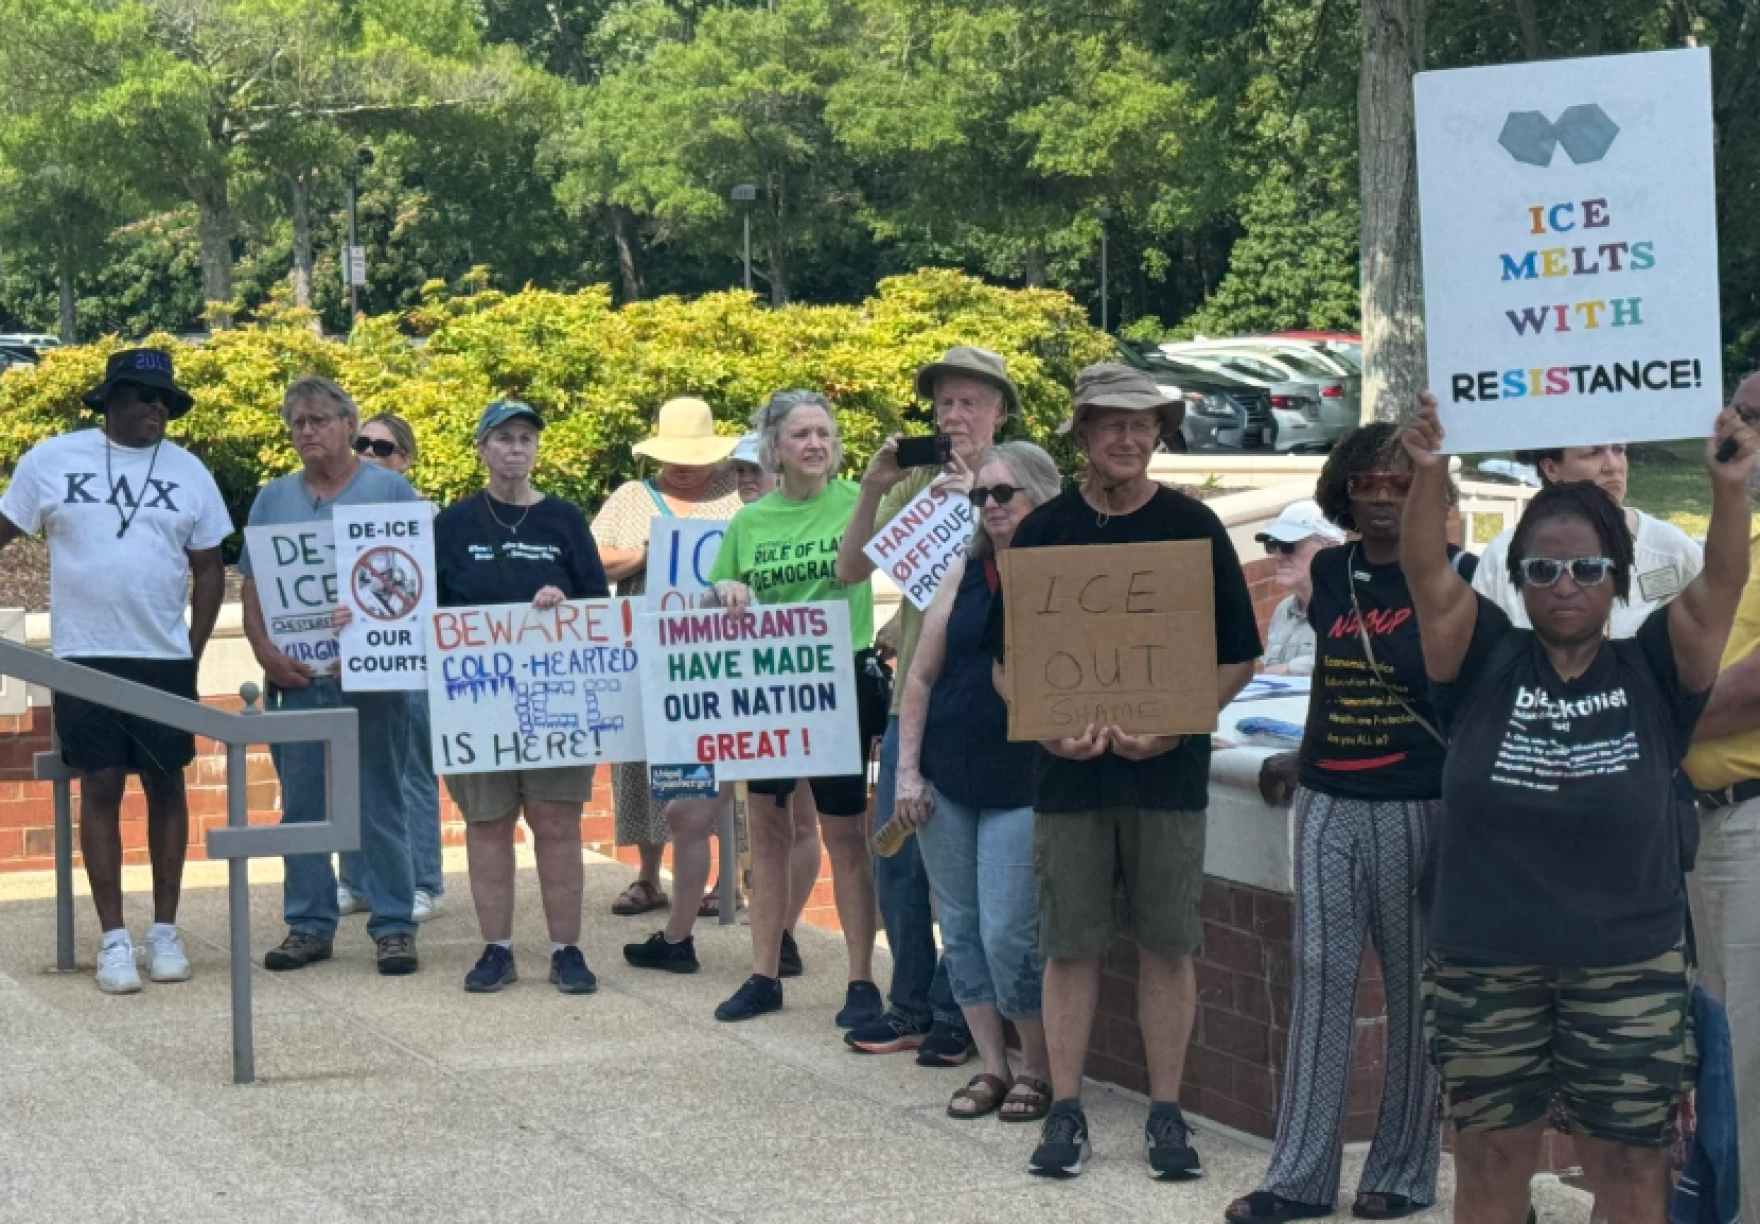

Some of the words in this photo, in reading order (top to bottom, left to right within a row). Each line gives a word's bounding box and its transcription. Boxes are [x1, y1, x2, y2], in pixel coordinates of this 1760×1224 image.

[1528, 197, 1610, 235] ICE
[1500, 241, 1656, 281] MELTS
[1506, 297, 1643, 335] WITH
[1451, 358, 1703, 403] RESISTANCE!
[349, 520, 420, 540] DE-ICE
[873, 486, 949, 559] HANDS
[933, 503, 972, 544] DUE
[795, 541, 815, 558] OF
[820, 536, 843, 554] LA
[275, 574, 338, 609] ICE
[1037, 570, 1158, 615] ICE
[366, 629, 412, 646] OUR
[659, 607, 828, 646] IMMIGRANTS
[668, 650, 743, 681] HAVE
[753, 644, 835, 675] MADE
[1045, 645, 1166, 690] OUT
[664, 691, 721, 721] OUR
[731, 682, 837, 716] NATION
[1051, 698, 1160, 726] SHAME
[441, 732, 476, 767] IS
[494, 729, 602, 767] HERE!
